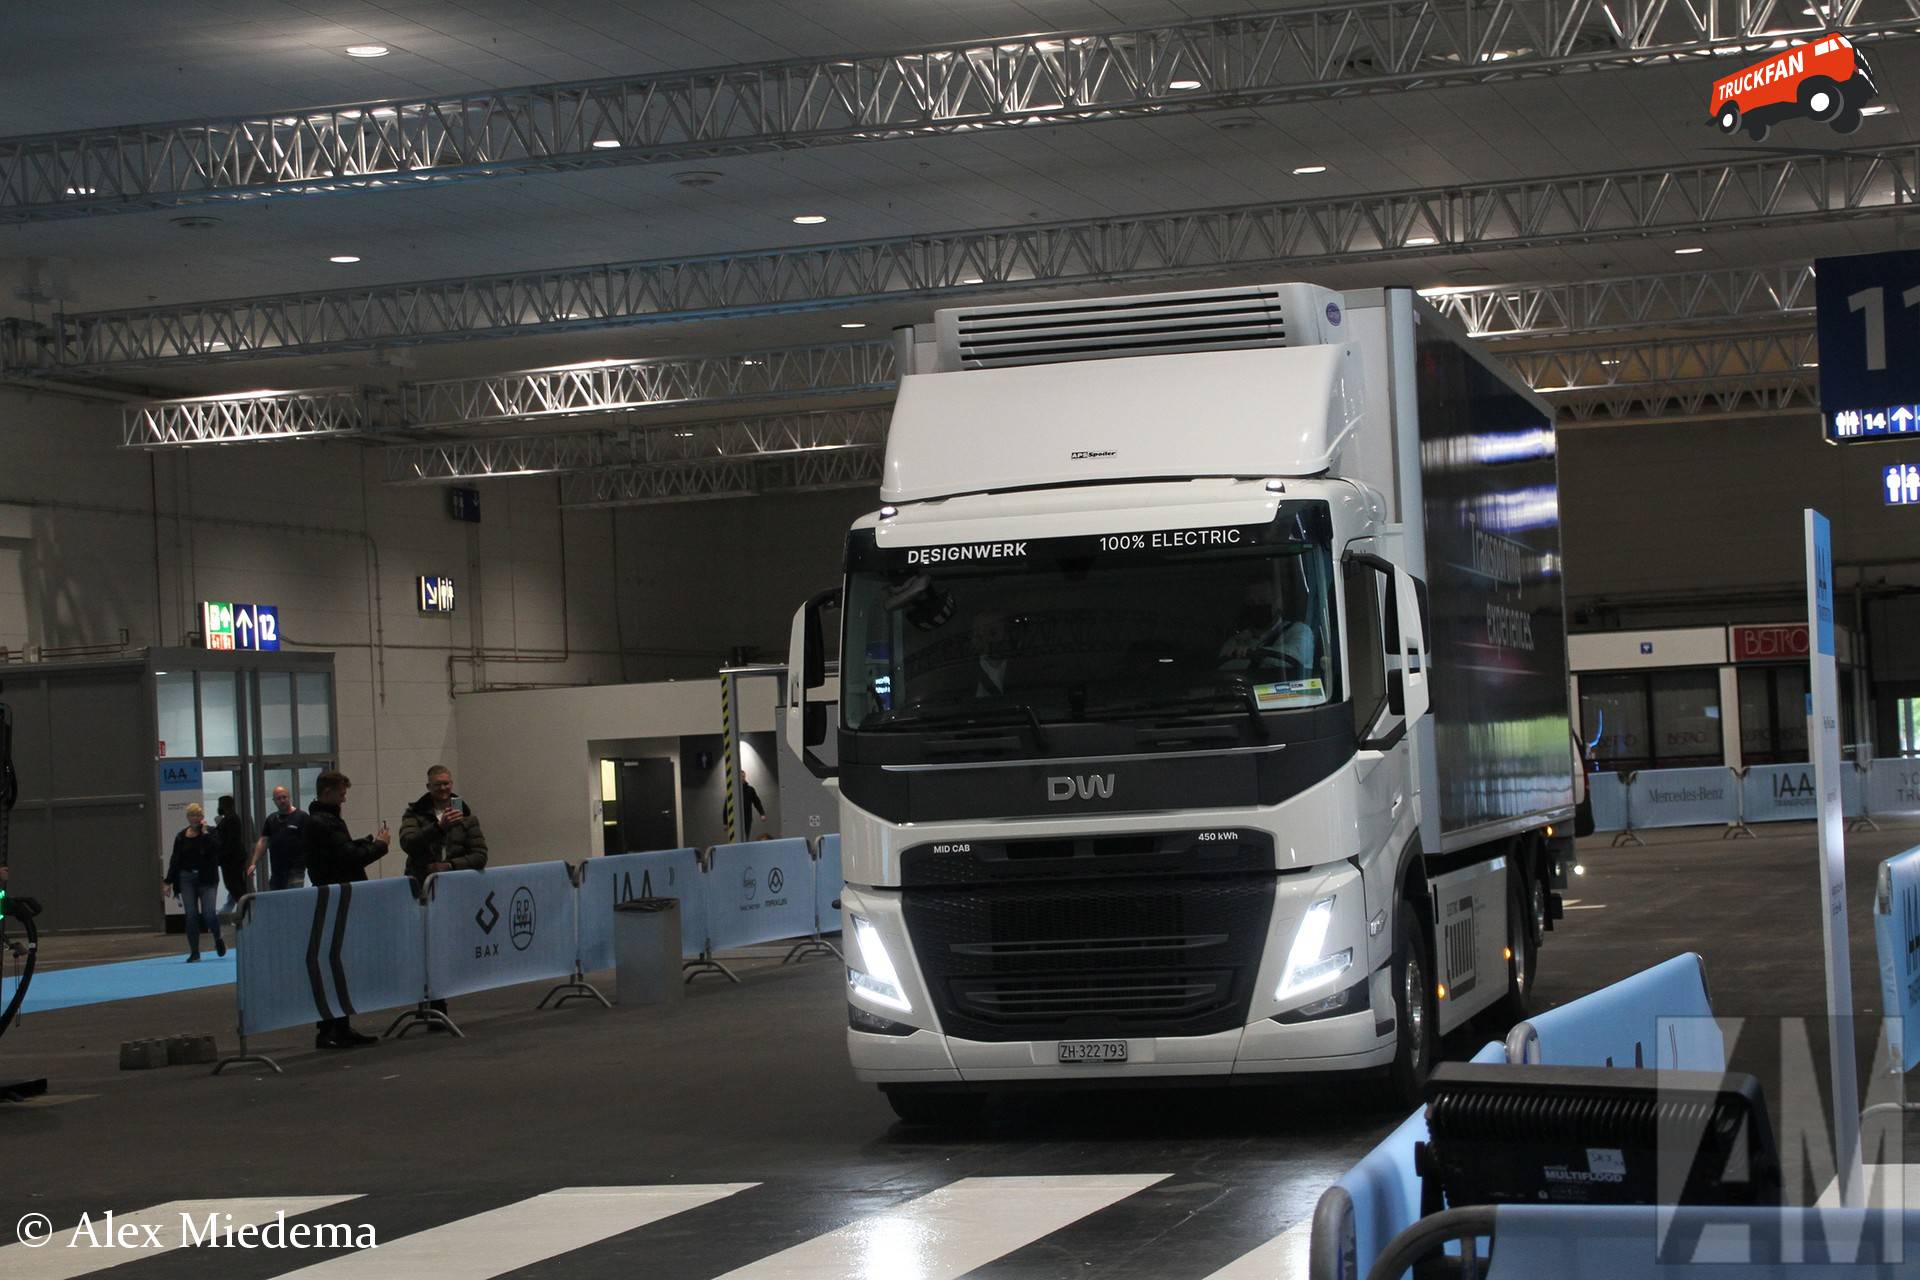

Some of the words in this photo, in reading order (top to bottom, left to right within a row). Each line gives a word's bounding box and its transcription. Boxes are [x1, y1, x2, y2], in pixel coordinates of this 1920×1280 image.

[1863, 412, 1887, 431] 14
[907, 542, 1028, 564] DESIGNWERK
[1099, 534, 1145, 551] 100%
[1151, 529, 1241, 548] ELECTRIC
[1469, 512, 1522, 600] Transporting
[258, 614, 277, 641] 12
[1486, 602, 1535, 660] experiences
[1744, 628, 1809, 655] BISTRO
[163, 767, 188, 780] IAA
[1772, 772, 1815, 798] IAA
[1047, 773, 1115, 801] DW
[1649, 785, 1725, 803] Mercedes-Benz
[933, 845, 951, 853] MID
[952, 844, 970, 853] CAB
[1198, 833, 1216, 841] 450
[1217, 831, 1238, 841] kWh
[475, 943, 499, 959] BAX
